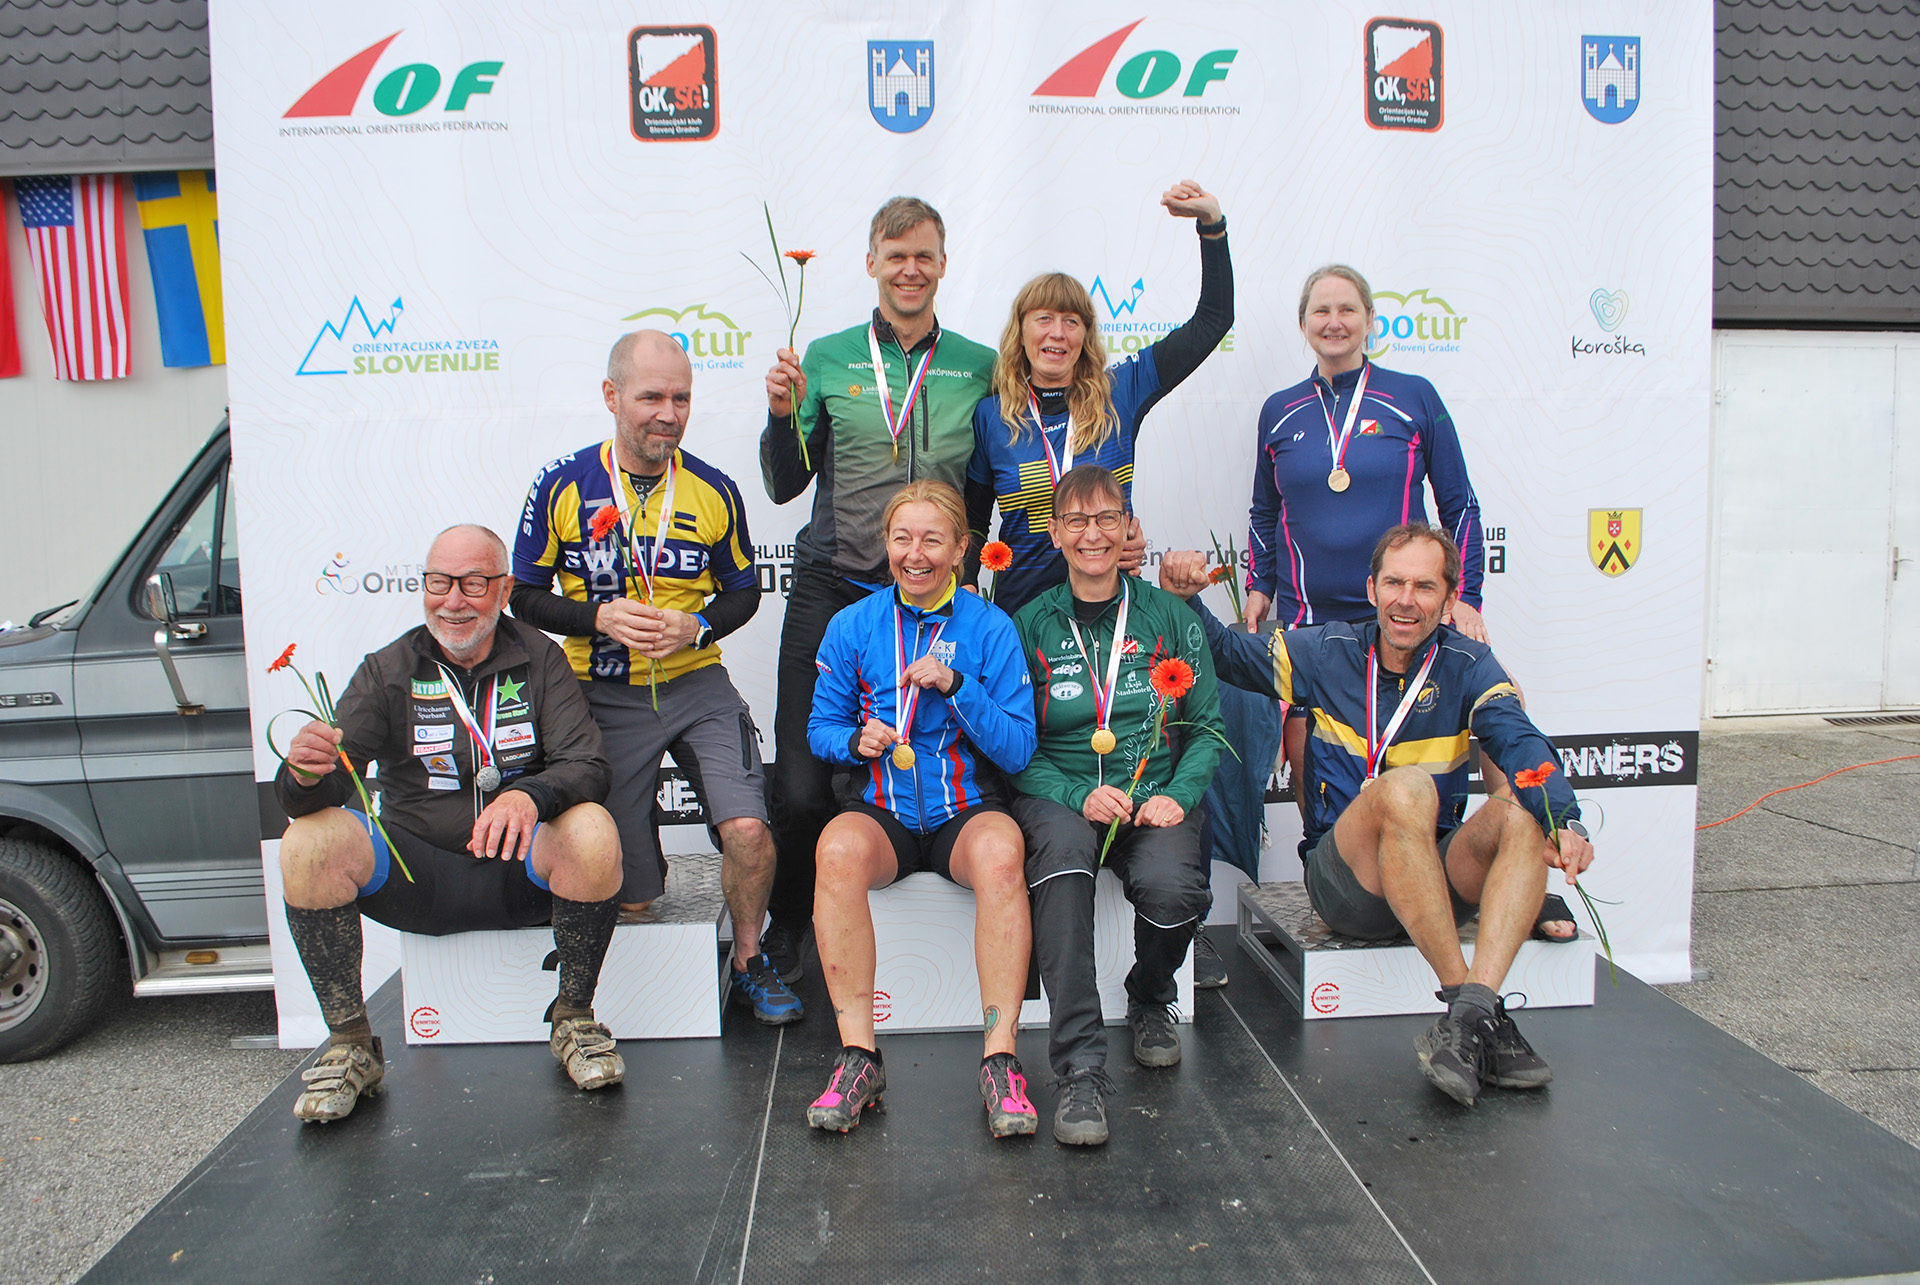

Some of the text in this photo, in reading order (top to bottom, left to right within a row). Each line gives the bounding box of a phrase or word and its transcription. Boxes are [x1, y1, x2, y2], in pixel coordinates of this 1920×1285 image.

[1029, 105, 1240, 115] INTERNATIONAL ORIENTEERING FEDERATION
[1379, 107, 1429, 117] Orientacijski klub
[644, 118, 703, 127] Orientacijski klub
[1383, 115, 1427, 124] Slovenj Gradec
[279, 120, 508, 138] INTERNATIONAL ORIENTEERING FEDERATION
[649, 126, 700, 135] Slovenj Gradec
[1098, 322, 1182, 332] ORIENTACIJSK
[352, 339, 499, 353] ORIENTACIJSKA ZVEZA
[1392, 342, 1460, 354] Slovenj Gradec
[1572, 335, 1645, 359] Koroška
[353, 352, 500, 375] SLOVENIJE
[707, 359, 744, 369] Gradec
[925, 368, 962, 378] NKÖPINGS
[1044, 422, 1067, 434] CRAFT
[522, 453, 577, 537] SWEDEN
[1486, 527, 1506, 541] UB
[413, 704, 451, 713] Ulricehamns
[417, 711, 447, 720] Sparbank
[1556, 742, 1684, 779] NNERS
